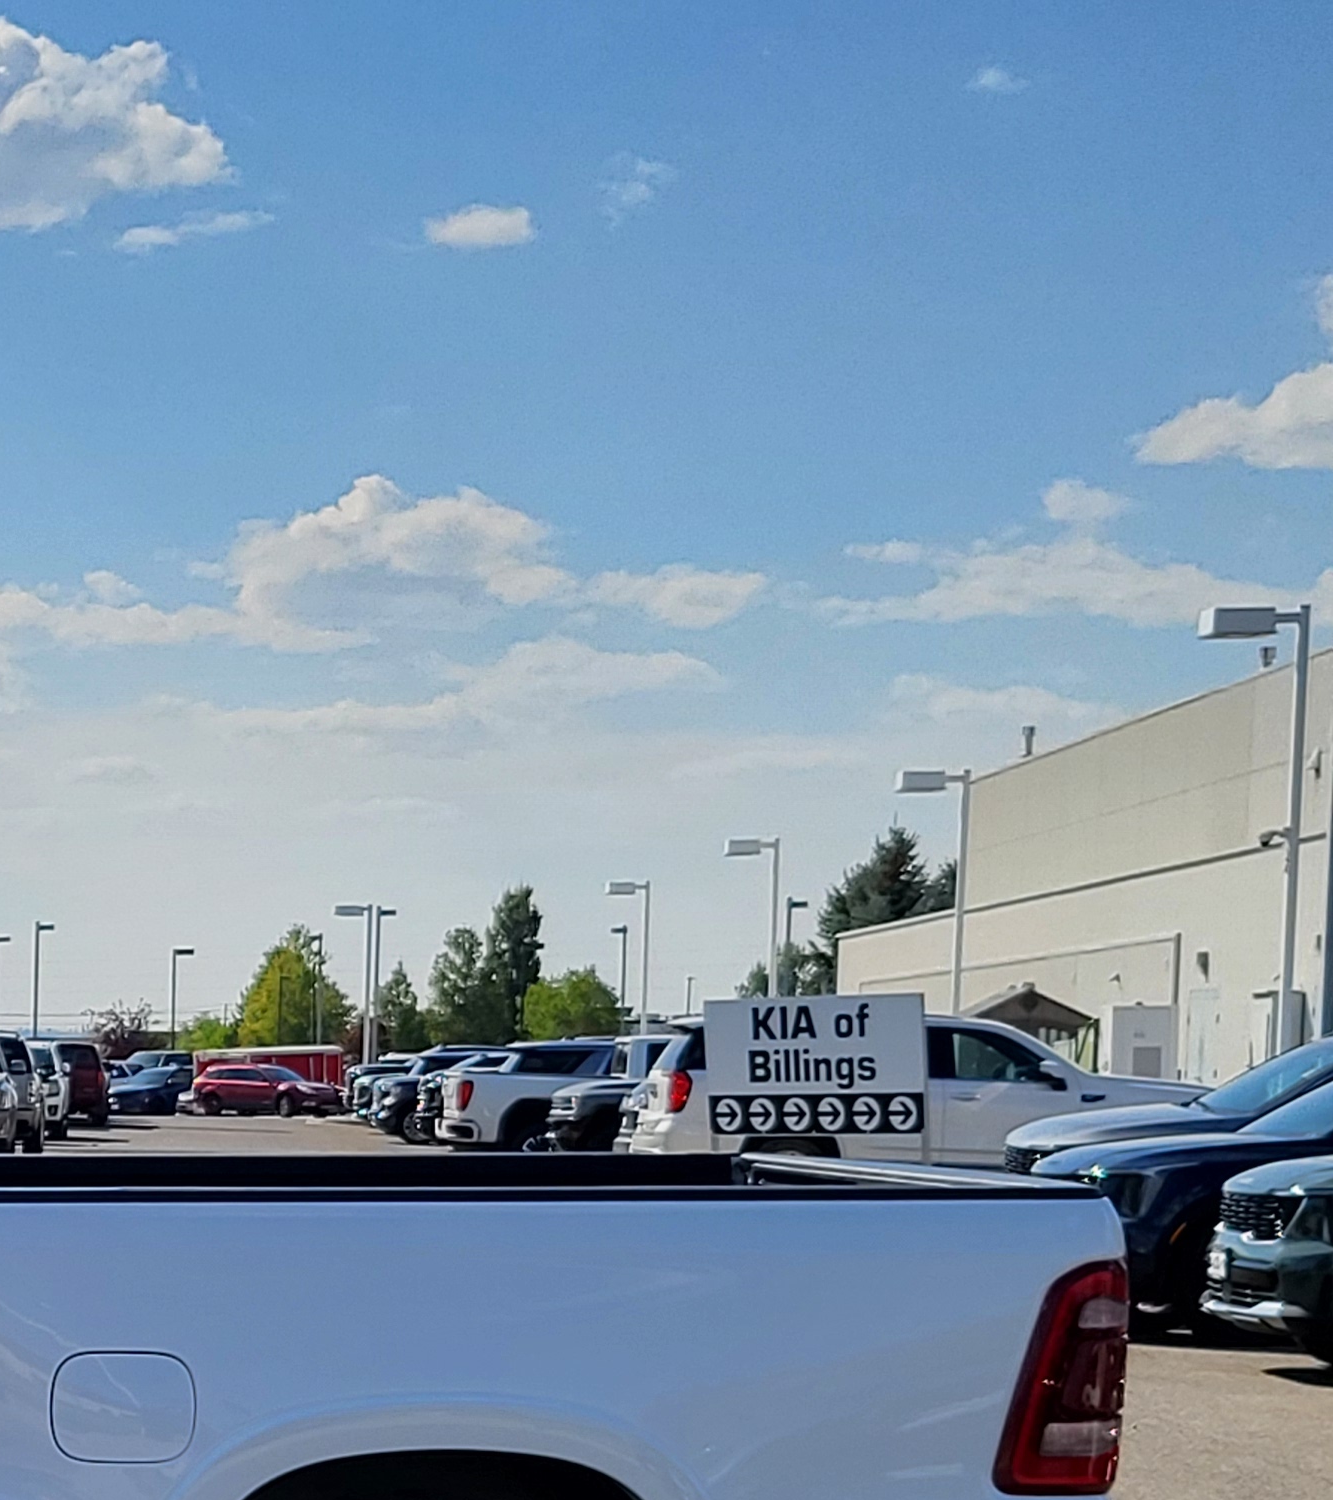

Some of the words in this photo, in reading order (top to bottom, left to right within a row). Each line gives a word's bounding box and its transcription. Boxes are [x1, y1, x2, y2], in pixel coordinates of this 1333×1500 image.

[751, 1005, 817, 1040] KIA
[834, 1003, 870, 1039] of
[748, 1048, 877, 1090] Billings
